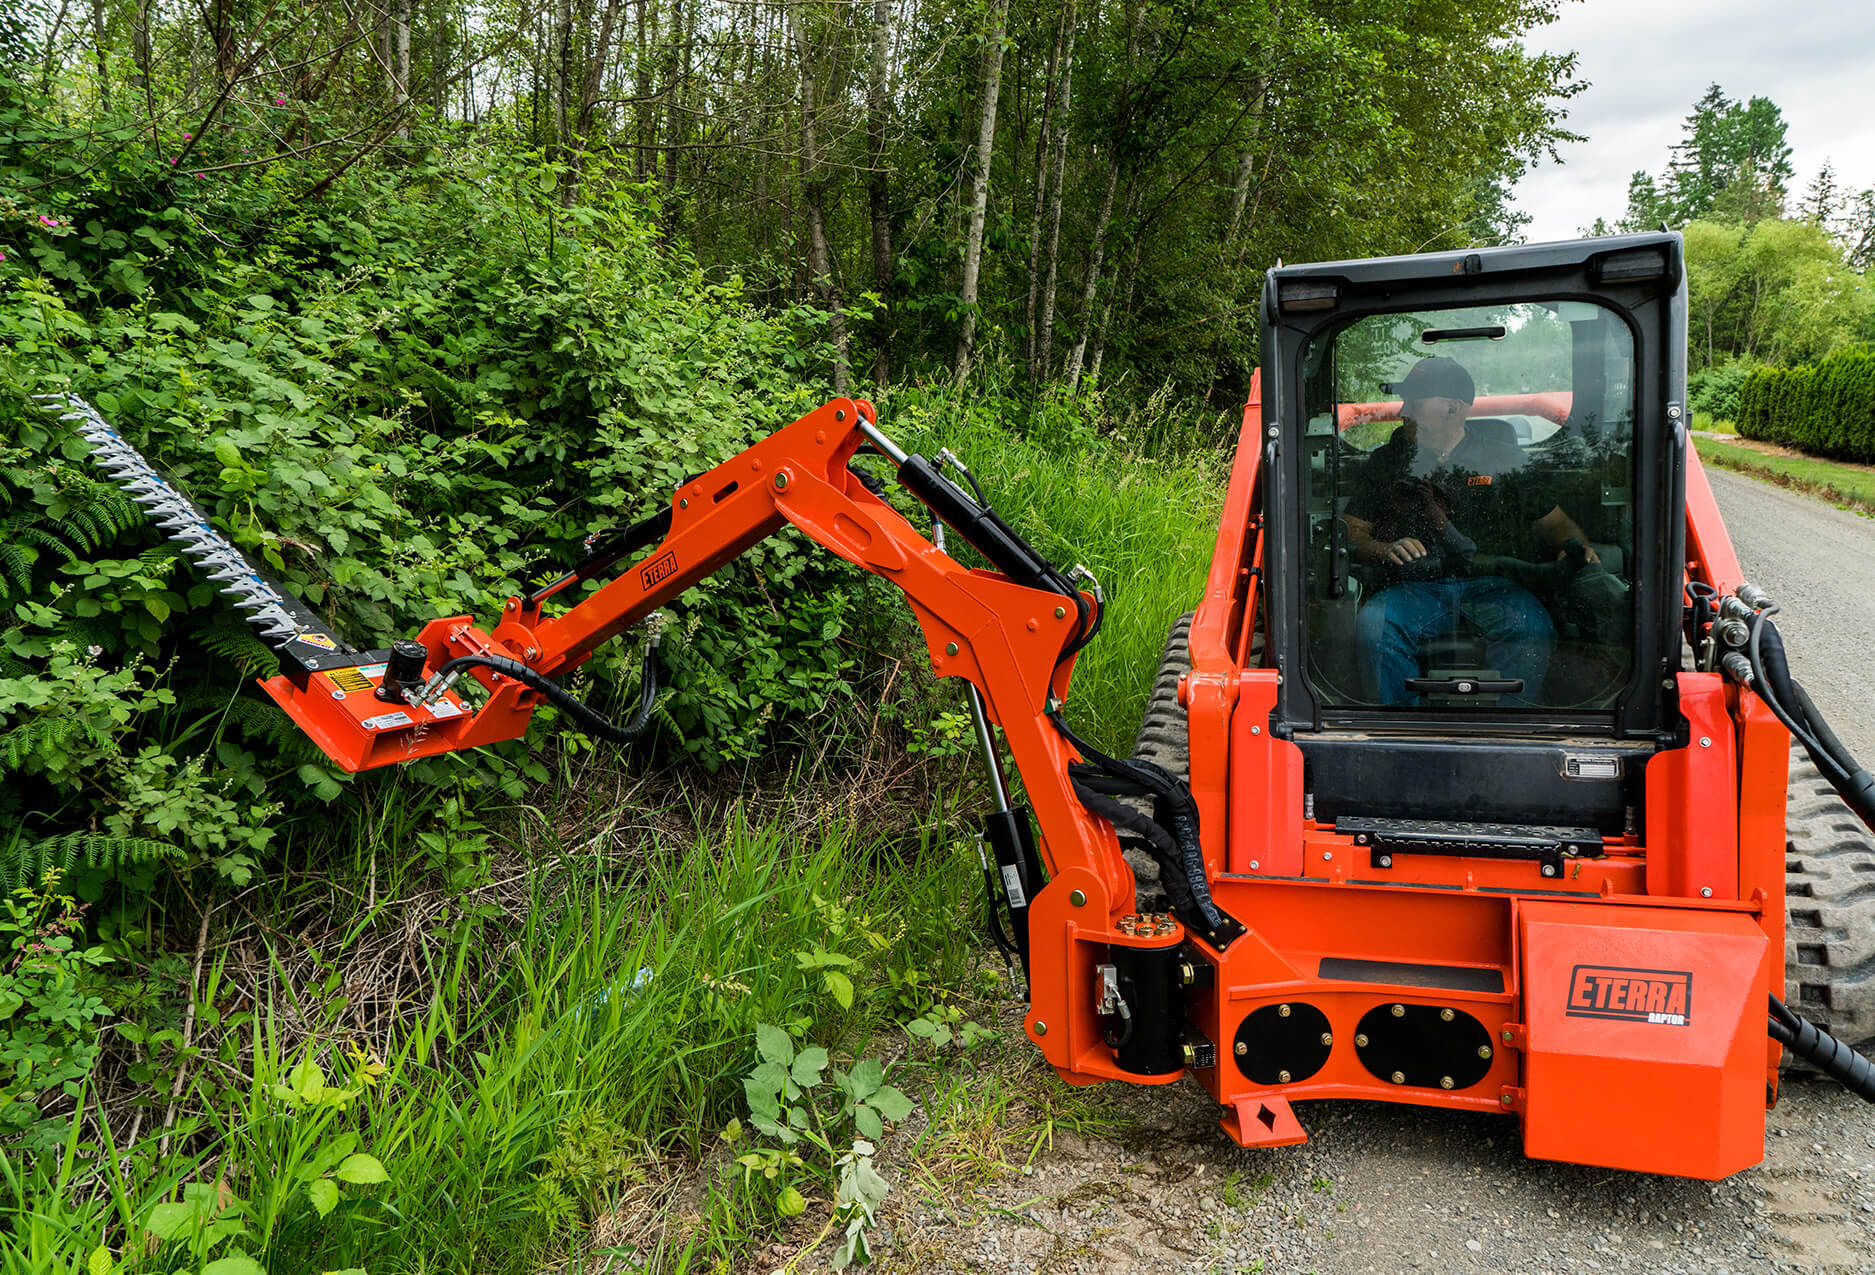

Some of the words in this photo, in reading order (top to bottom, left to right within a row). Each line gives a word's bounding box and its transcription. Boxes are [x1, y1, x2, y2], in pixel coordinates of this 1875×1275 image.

[641, 552, 678, 590] ETERRA
[1570, 967, 1687, 1014] ETERRA
[1648, 1013, 1685, 1025] RAPTOR
